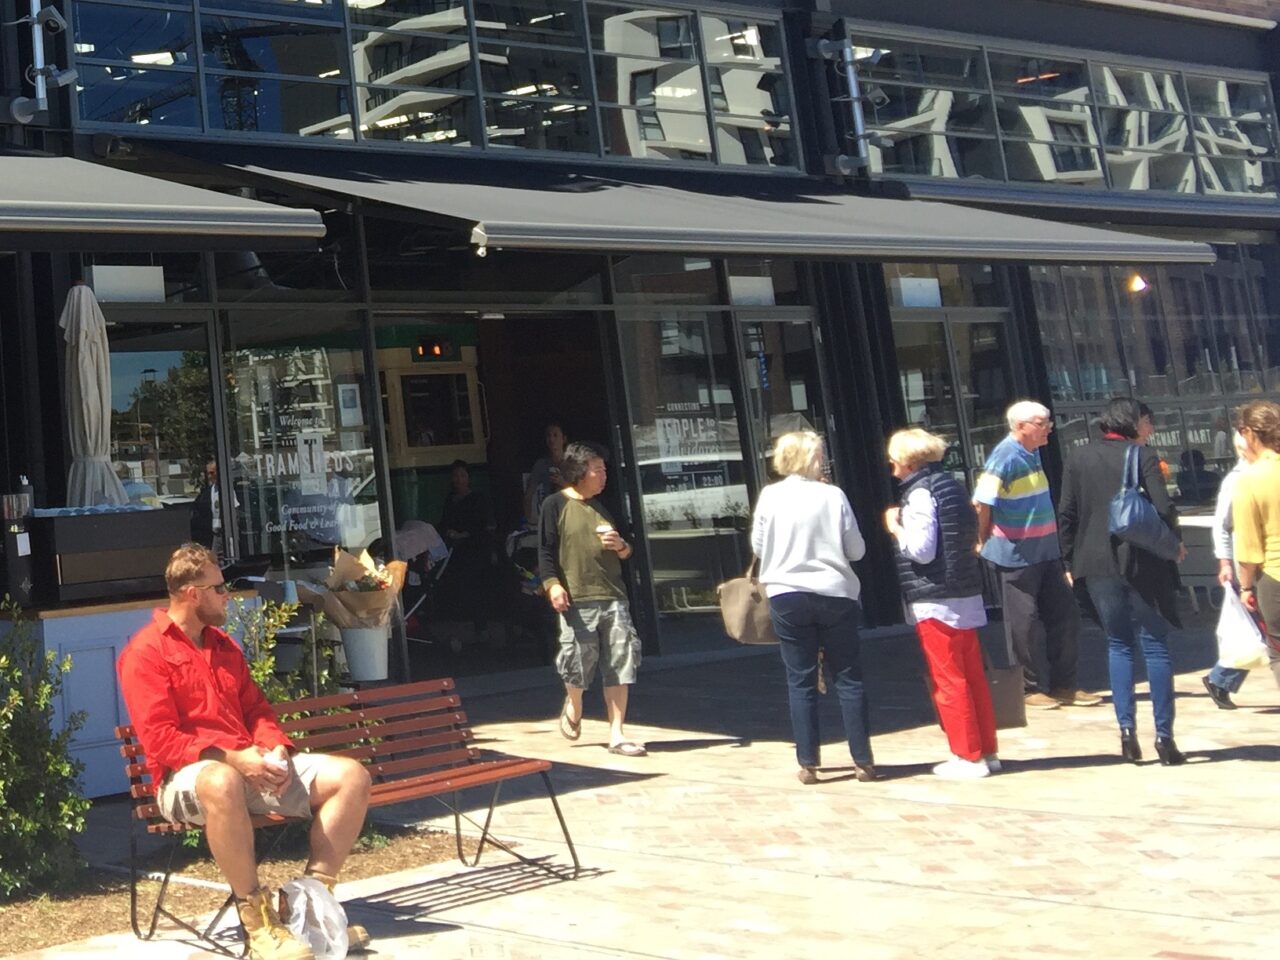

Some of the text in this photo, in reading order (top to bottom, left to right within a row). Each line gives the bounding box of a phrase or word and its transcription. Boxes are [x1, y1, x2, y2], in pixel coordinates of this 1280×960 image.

[279, 415, 313, 428] Welcome
[253, 450, 355, 477] TRAMSHEDS
[281, 503, 326, 516] Community
[265, 520, 287, 533] Good
[288, 518, 308, 531] Food
